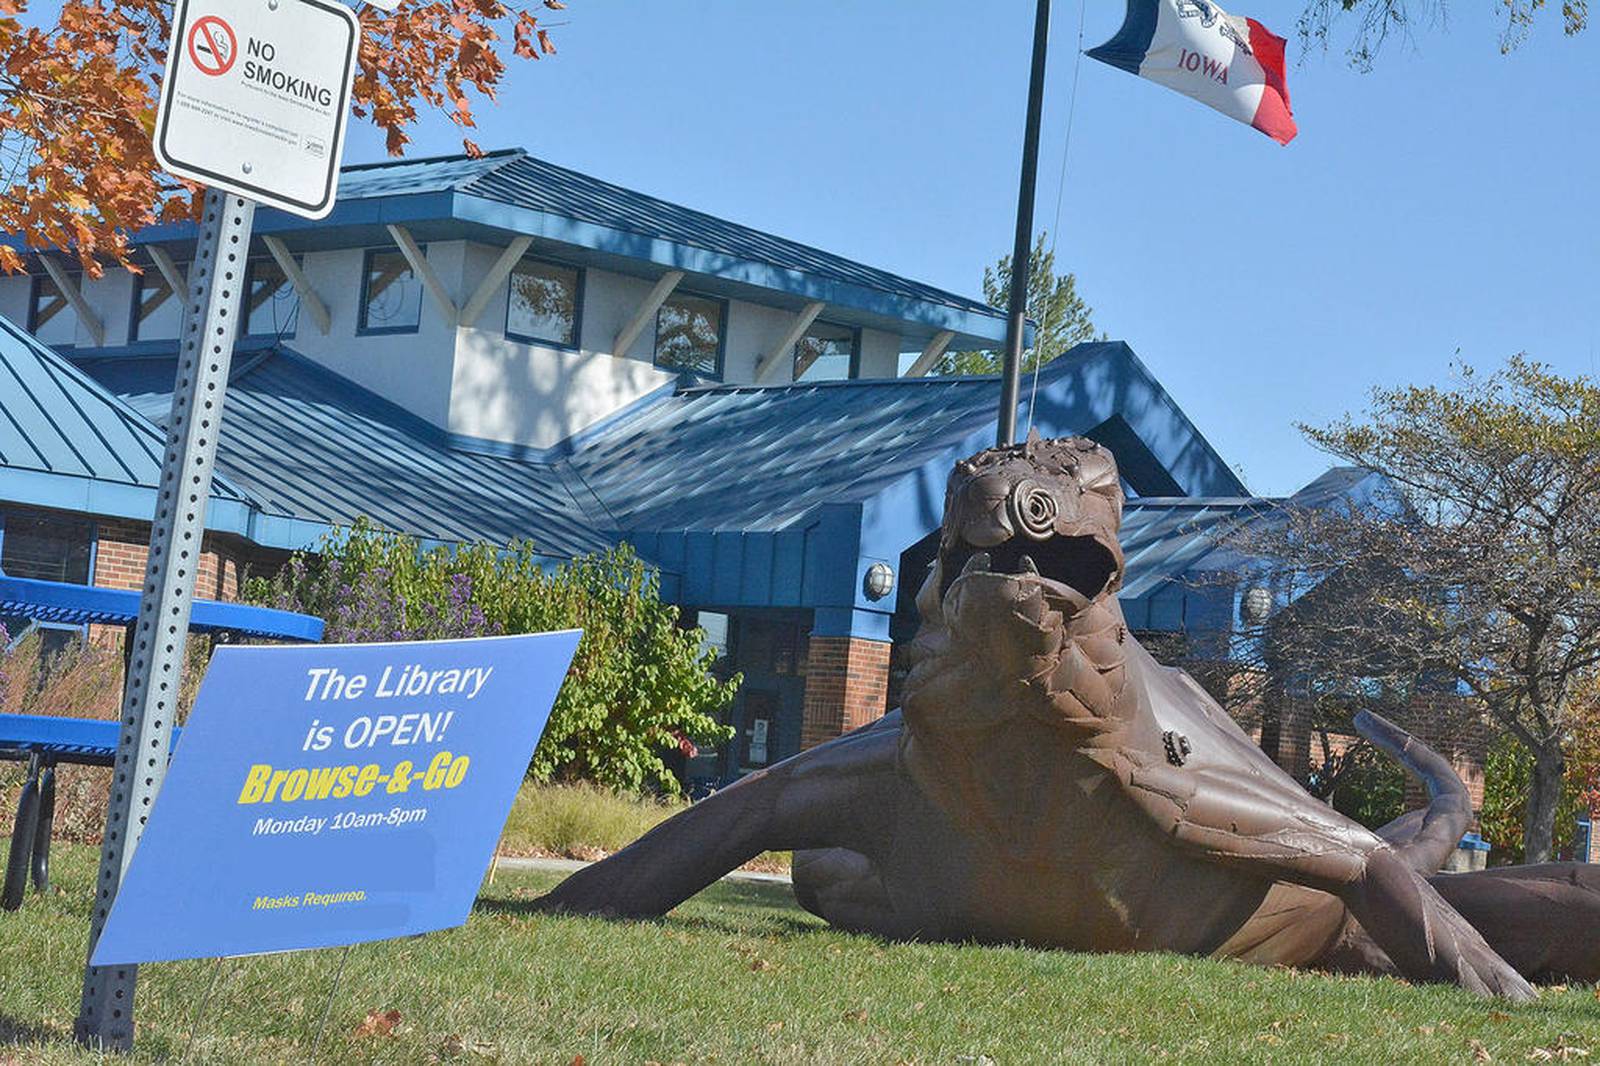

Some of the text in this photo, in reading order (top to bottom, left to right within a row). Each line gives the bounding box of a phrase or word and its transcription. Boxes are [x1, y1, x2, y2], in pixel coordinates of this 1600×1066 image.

[247, 36, 275, 62] NO
[1178, 47, 1229, 85] IOWA
[243, 60, 332, 107] SMOKING
[304, 664, 494, 701] The Library
[302, 711, 454, 751] is OPEN!
[237, 751, 470, 804] Browse-&-Go
[252, 807, 428, 836] Monday 10am-8pm
[252, 895, 300, 911] Masks
